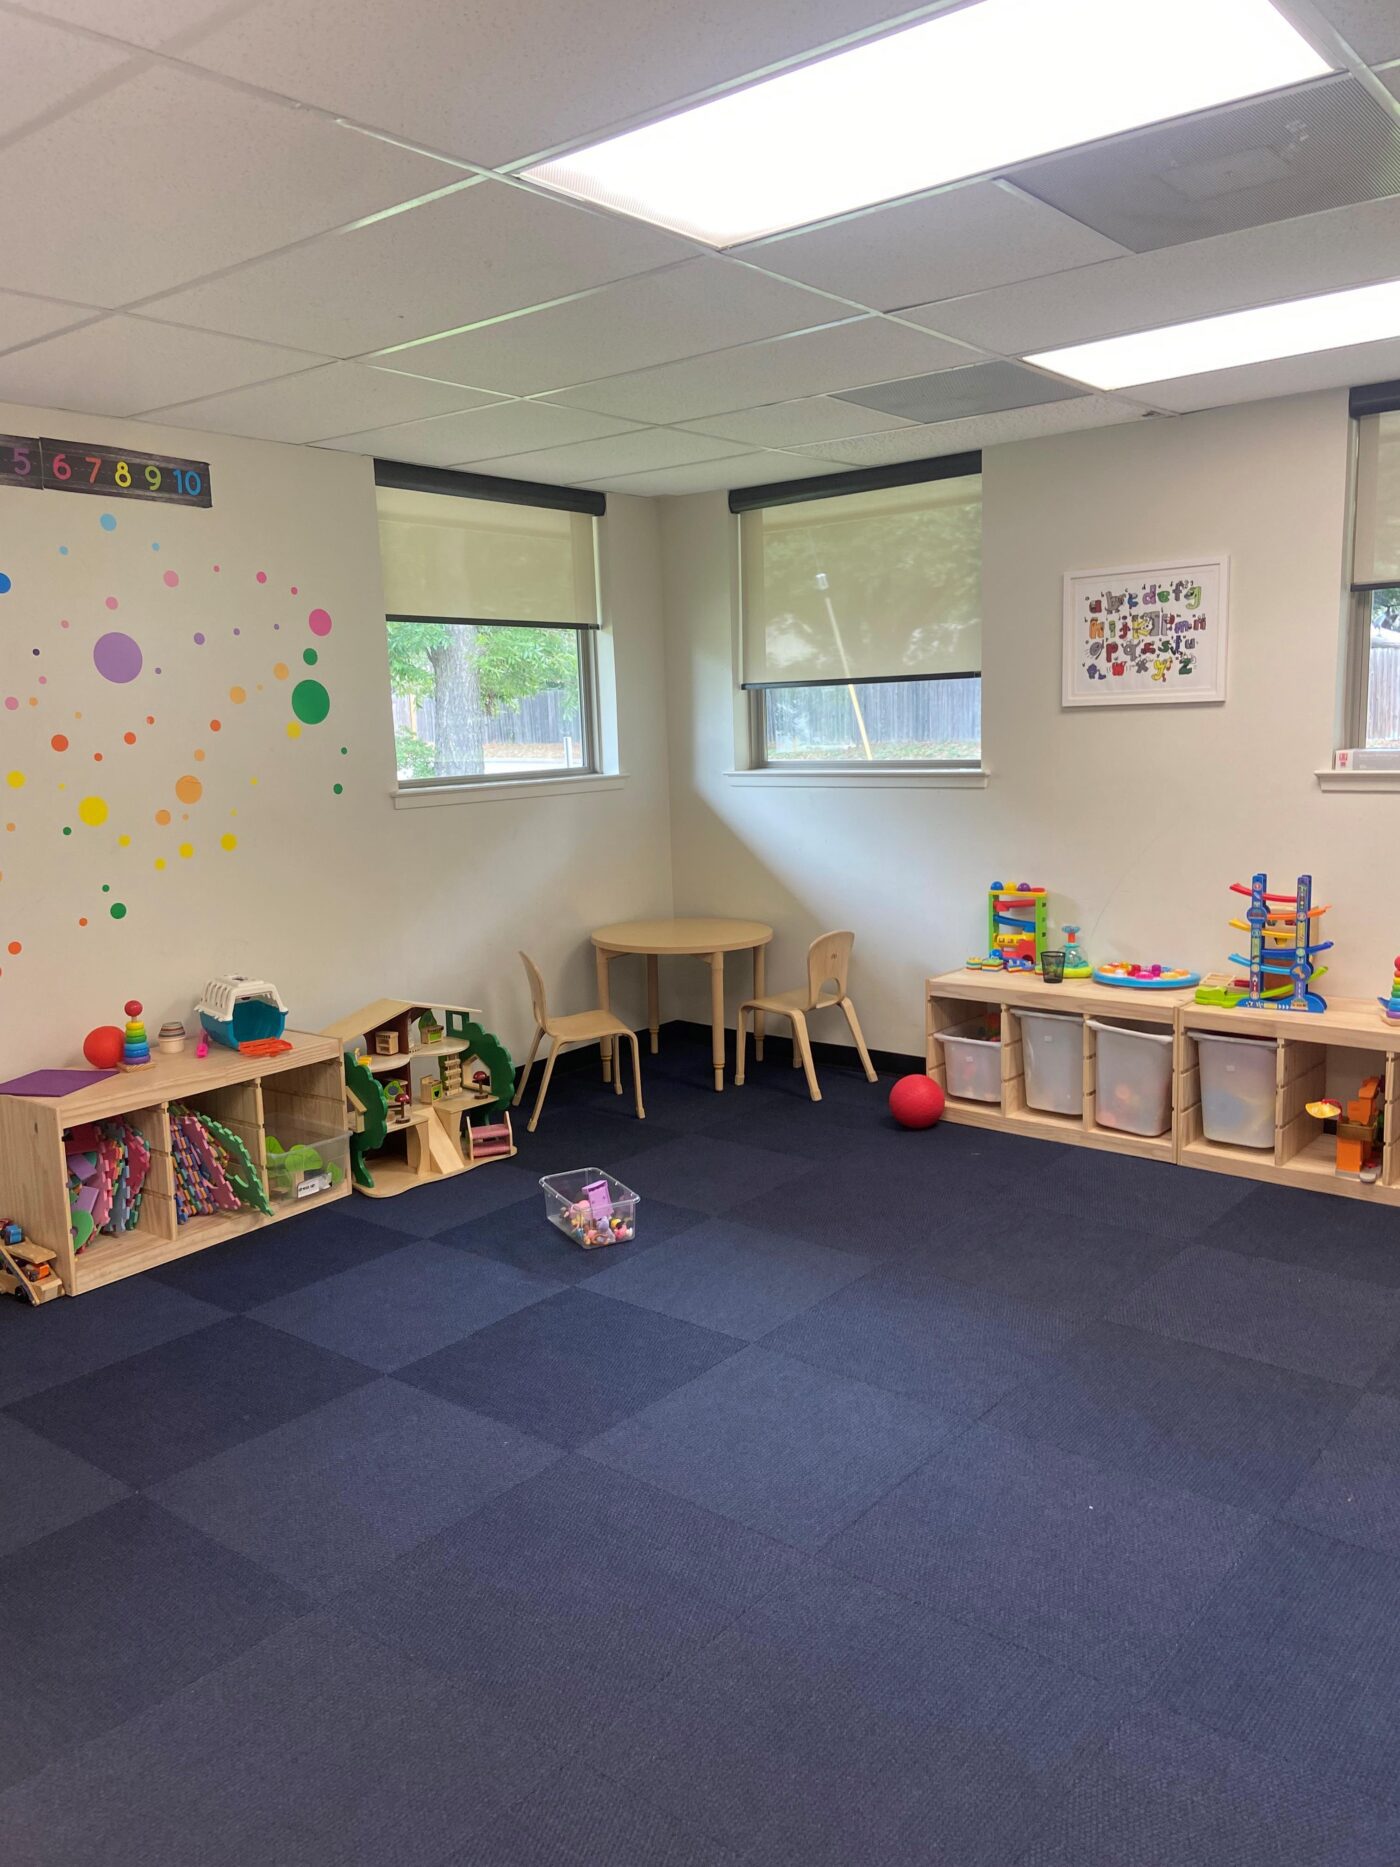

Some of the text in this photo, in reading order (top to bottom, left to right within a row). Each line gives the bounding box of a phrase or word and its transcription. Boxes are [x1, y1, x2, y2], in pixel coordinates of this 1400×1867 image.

[14, 447, 201, 496] 5 6 7 8 9 10
[1089, 600, 1102, 613] a
[1106, 591, 1125, 613] b
[1143, 585, 1156, 604] d
[1157, 591, 1170, 602] e
[1173, 581, 1183, 601] f
[1184, 587, 1201, 609] g
[1175, 620, 1190, 634] m
[1106, 643, 1118, 662] p
[1123, 643, 1138, 661] q
[1158, 641, 1171, 653] s
[1185, 639, 1195, 649] u
[1152, 660, 1169, 681] y
